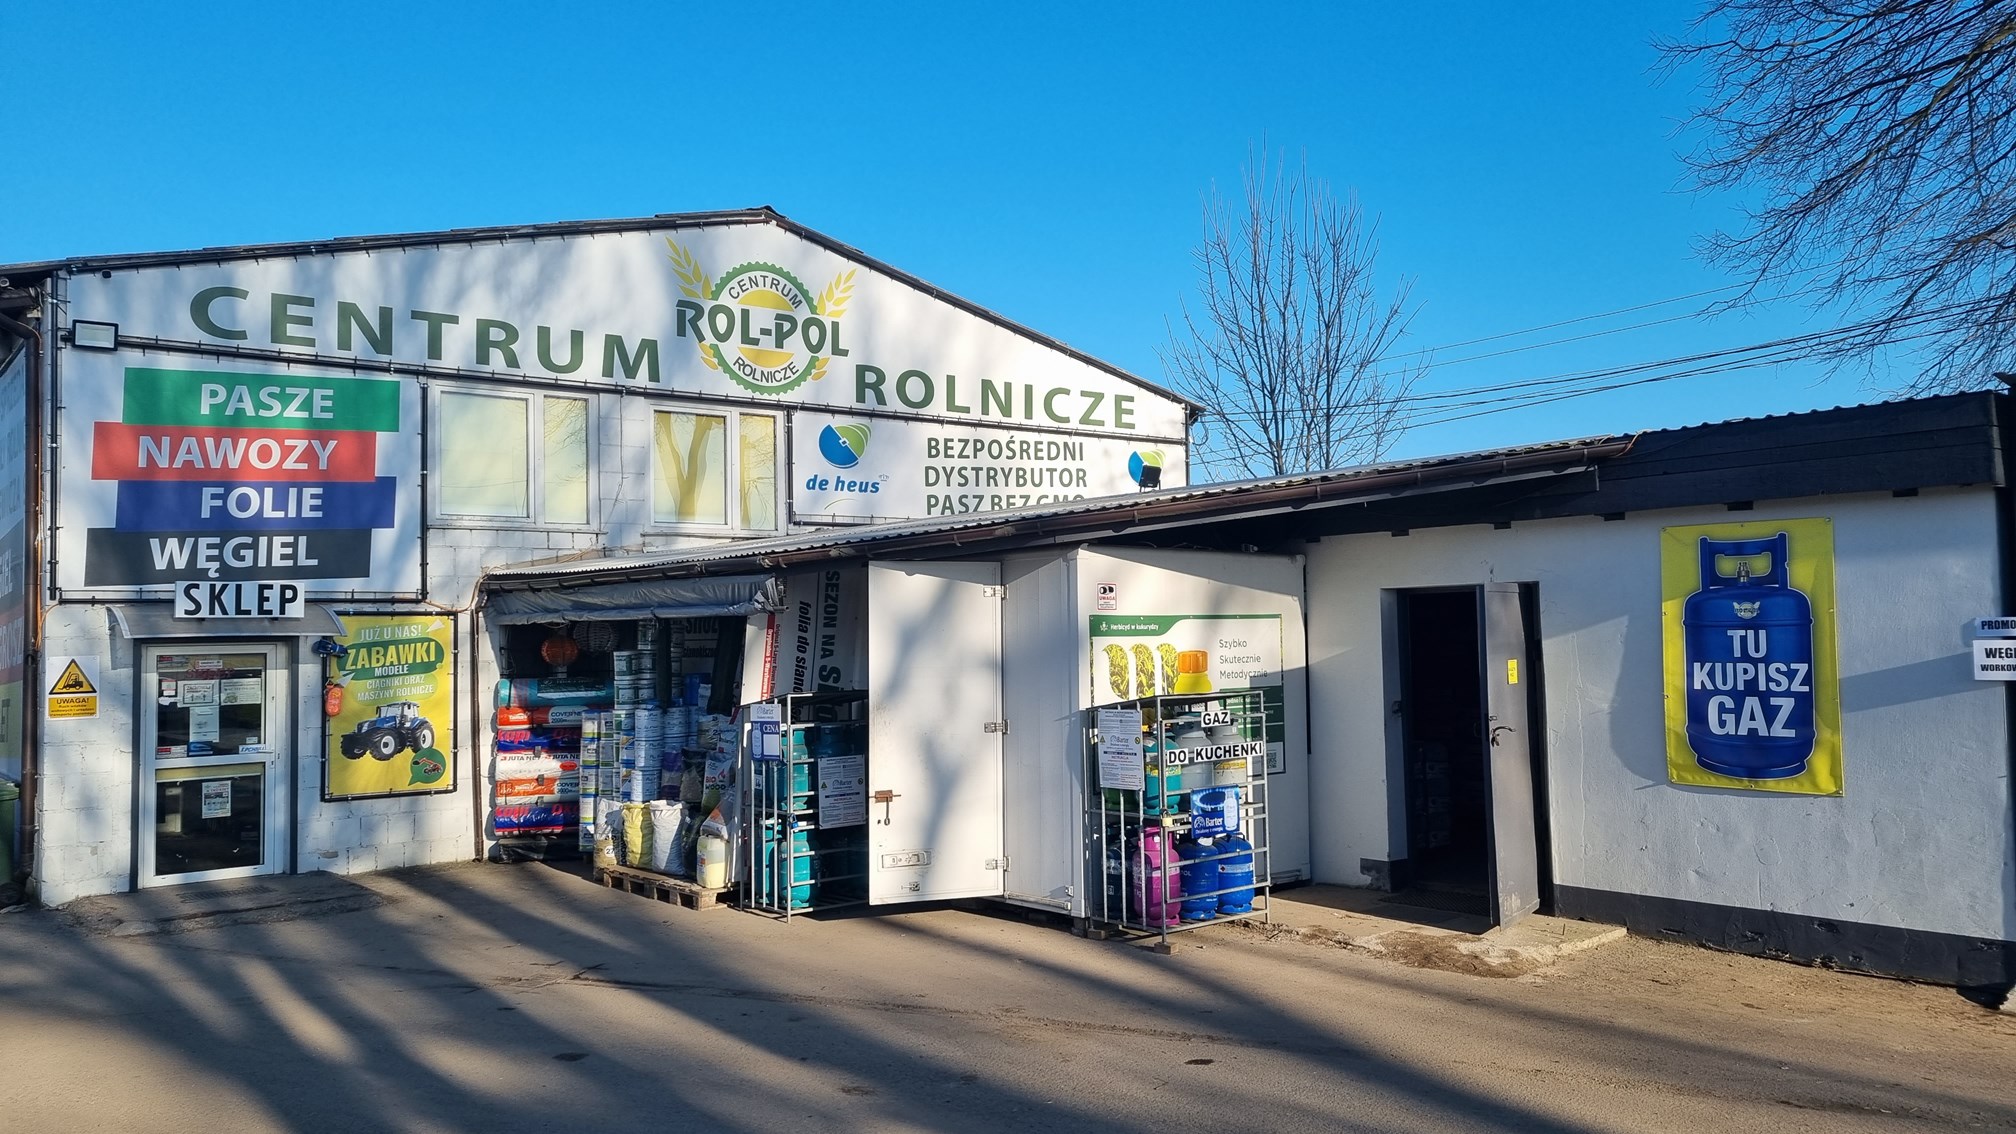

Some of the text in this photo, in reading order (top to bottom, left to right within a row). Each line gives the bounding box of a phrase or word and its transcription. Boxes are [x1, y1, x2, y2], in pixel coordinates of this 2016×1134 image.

[728, 275, 803, 309] CENTRUM
[190, 286, 661, 383] CENTRUM
[675, 299, 850, 358] ROL-POL
[733, 356, 800, 384] ROLNICZE
[200, 383, 335, 420] PASZE
[855, 364, 1136, 430] ROLNICZE
[137, 435, 339, 471] NAWOZY
[927, 435, 1085, 462] BEZPOŚREDNI
[805, 473, 880, 494] de heus
[924, 466, 1088, 488] DYSTRYBUTOR
[200, 486, 323, 519] FOLIE
[926, 494, 985, 516] PASZ
[149, 535, 319, 578] WĘGIEL
[183, 583, 299, 616] SKLEP
[822, 570, 841, 629] SEZON
[798, 600, 812, 634] folia
[360, 625, 422, 642] JUŻ U NAS!
[796, 634, 810, 654] do
[820, 634, 836, 660] NA
[1219, 638, 1248, 650] Szybko
[1727, 629, 1767, 658] TU
[345, 641, 436, 670] ZABAWKI
[1219, 653, 1261, 664] Skutecznie
[366, 675, 425, 690] CIĄGNIKI ORAZ
[374, 665, 409, 677] MODELE
[1219, 667, 1268, 680] Metodycznie
[1693, 662, 1810, 692] KUPISZ
[357, 685, 434, 701] MASZYNY ROLNICZE
[763, 724, 779, 733] CENA
[1202, 711, 1229, 726] GAZ
[1707, 695, 1796, 738] GAZ
[1168, 742, 1262, 764] DO KUCHENKI
[1205, 817, 1224, 827] Barter
